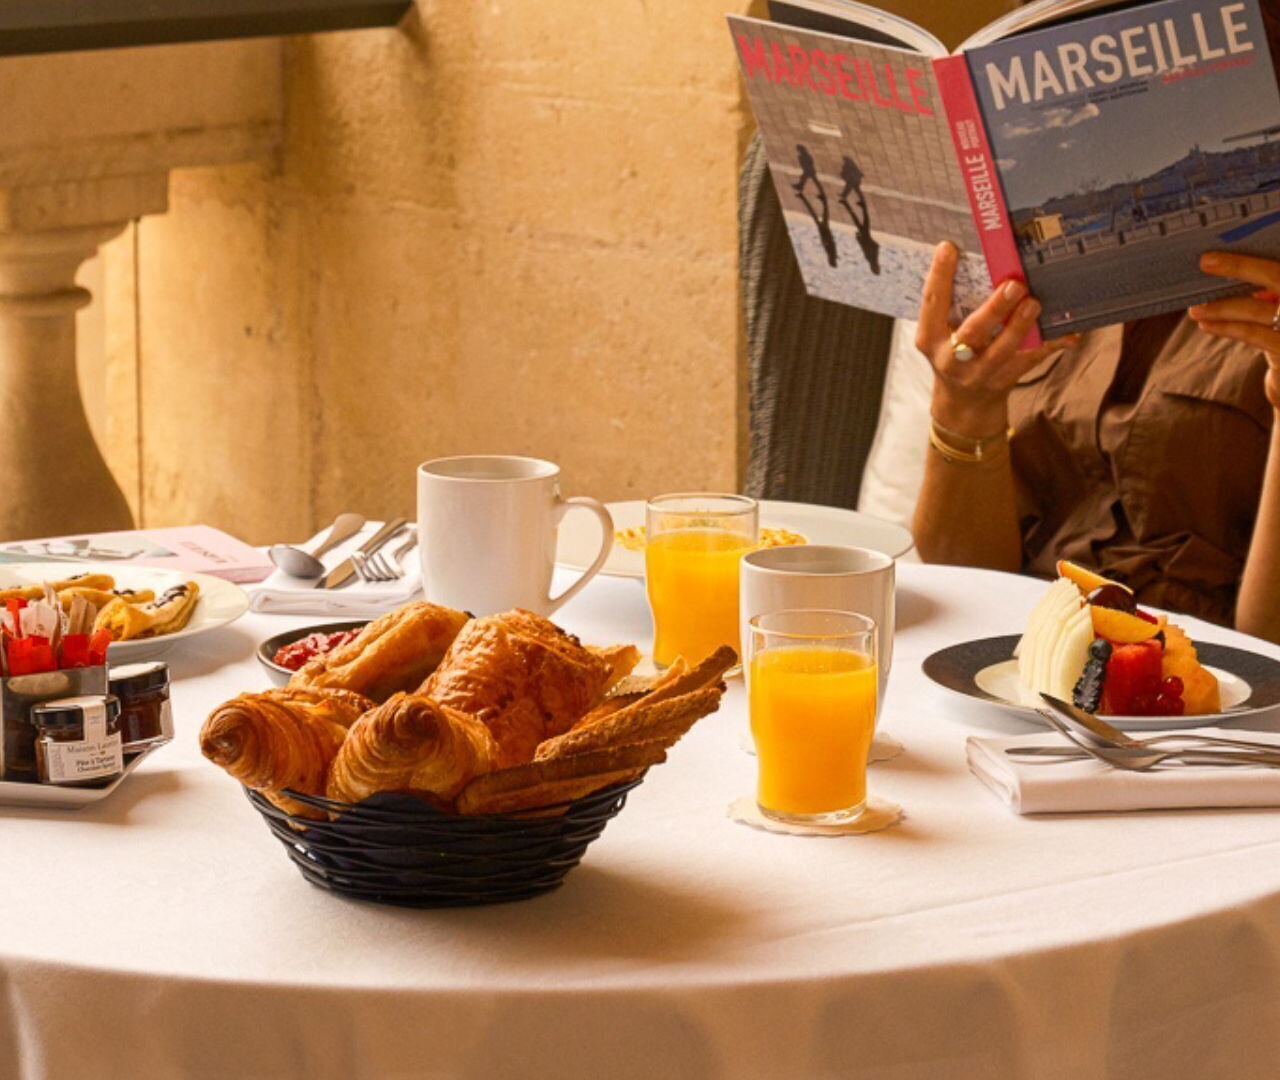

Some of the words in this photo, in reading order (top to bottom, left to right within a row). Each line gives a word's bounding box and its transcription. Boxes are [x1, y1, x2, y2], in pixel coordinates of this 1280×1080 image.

[738, 35, 933, 115] MARSEILLE
[985, 3, 1254, 111] MARSEILLE
[964, 153, 1002, 231] MARSEILLE
